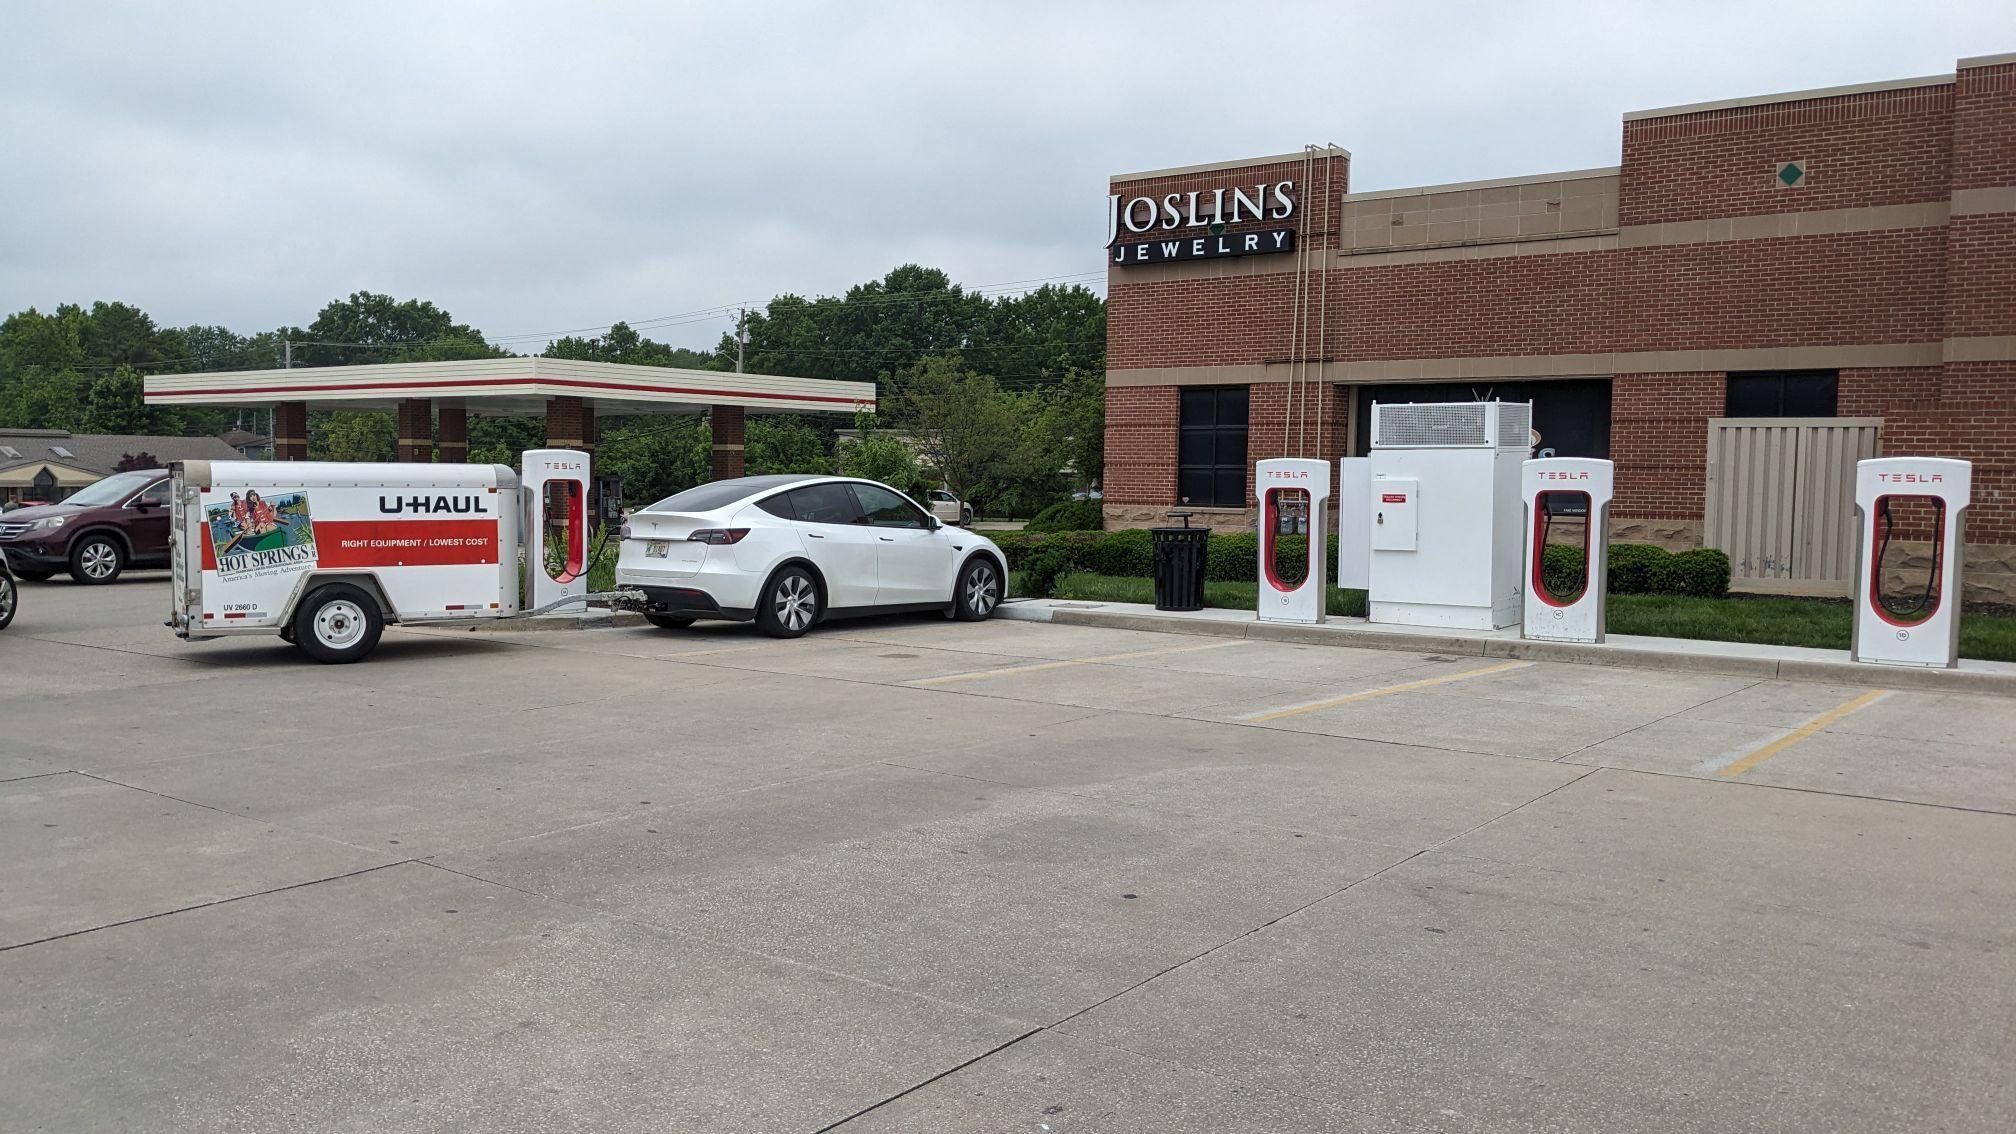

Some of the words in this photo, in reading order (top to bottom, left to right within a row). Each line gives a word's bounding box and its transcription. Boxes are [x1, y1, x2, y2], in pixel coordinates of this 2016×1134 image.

[1103, 181, 1296, 250] JOSLINS
[1114, 231, 1287, 263] JEWELRY
[544, 462, 581, 470] TESLA
[1266, 471, 1308, 479] TESLA
[1537, 471, 1589, 480] TESLA
[1878, 473, 1943, 483] TESLA
[378, 495, 488, 514] U-HAUL
[341, 539, 368, 548] RIGHT
[370, 538, 422, 547] EQUIPMENT
[429, 538, 463, 547] LOWEST
[465, 537, 488, 546] COST
[220, 554, 249, 573] HOT
[251, 544, 309, 568] SPRINGS
[222, 571, 253, 583] America's
[254, 569, 279, 578] Moving
[280, 564, 312, 574] Adventure
